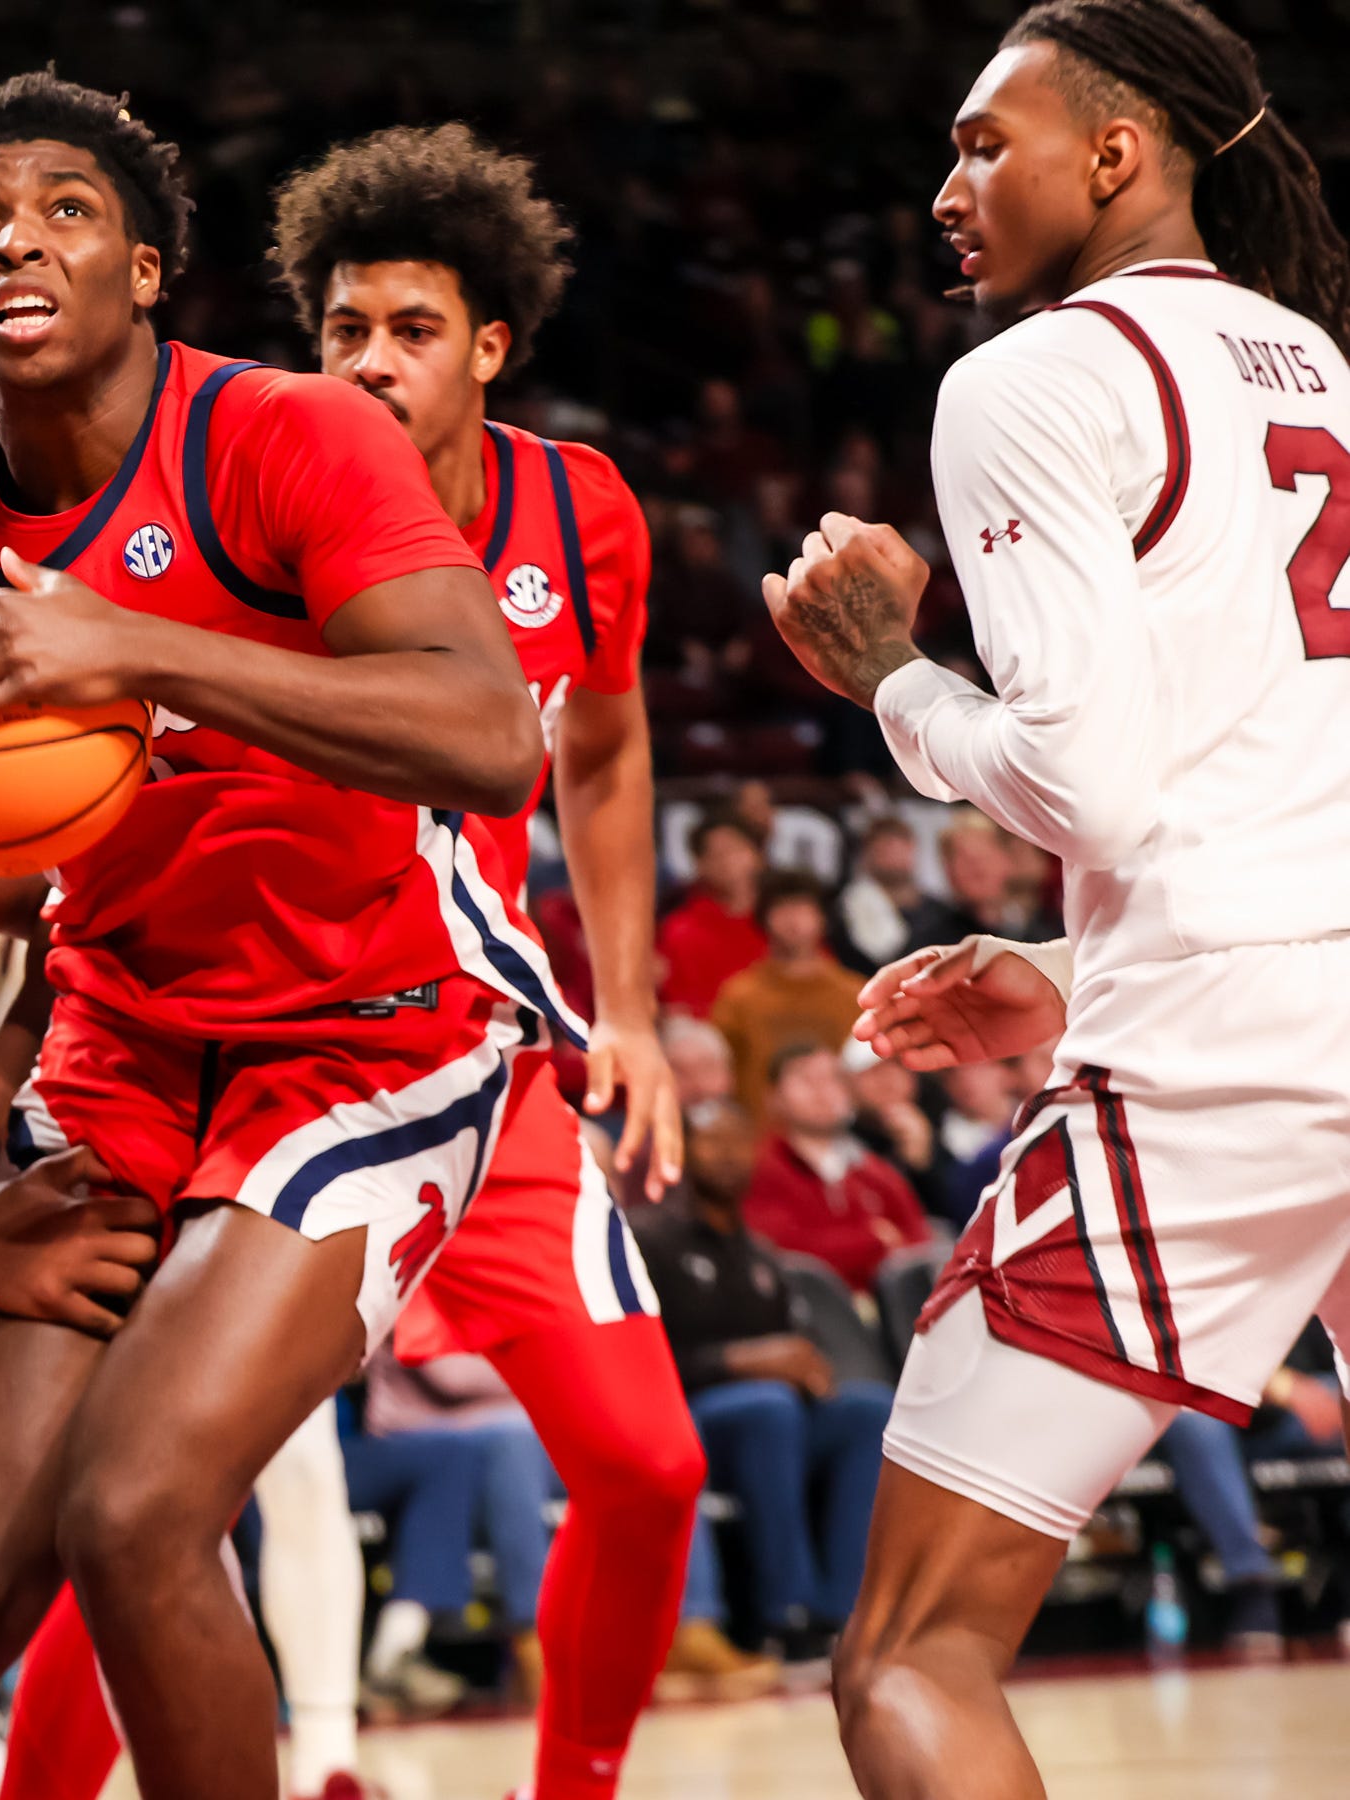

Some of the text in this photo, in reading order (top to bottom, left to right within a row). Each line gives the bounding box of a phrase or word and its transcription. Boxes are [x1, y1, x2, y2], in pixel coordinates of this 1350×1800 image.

[1216, 331, 1327, 393] DAVIS
[124, 524, 173, 578] SEC
[1263, 421, 1350, 660] 2
